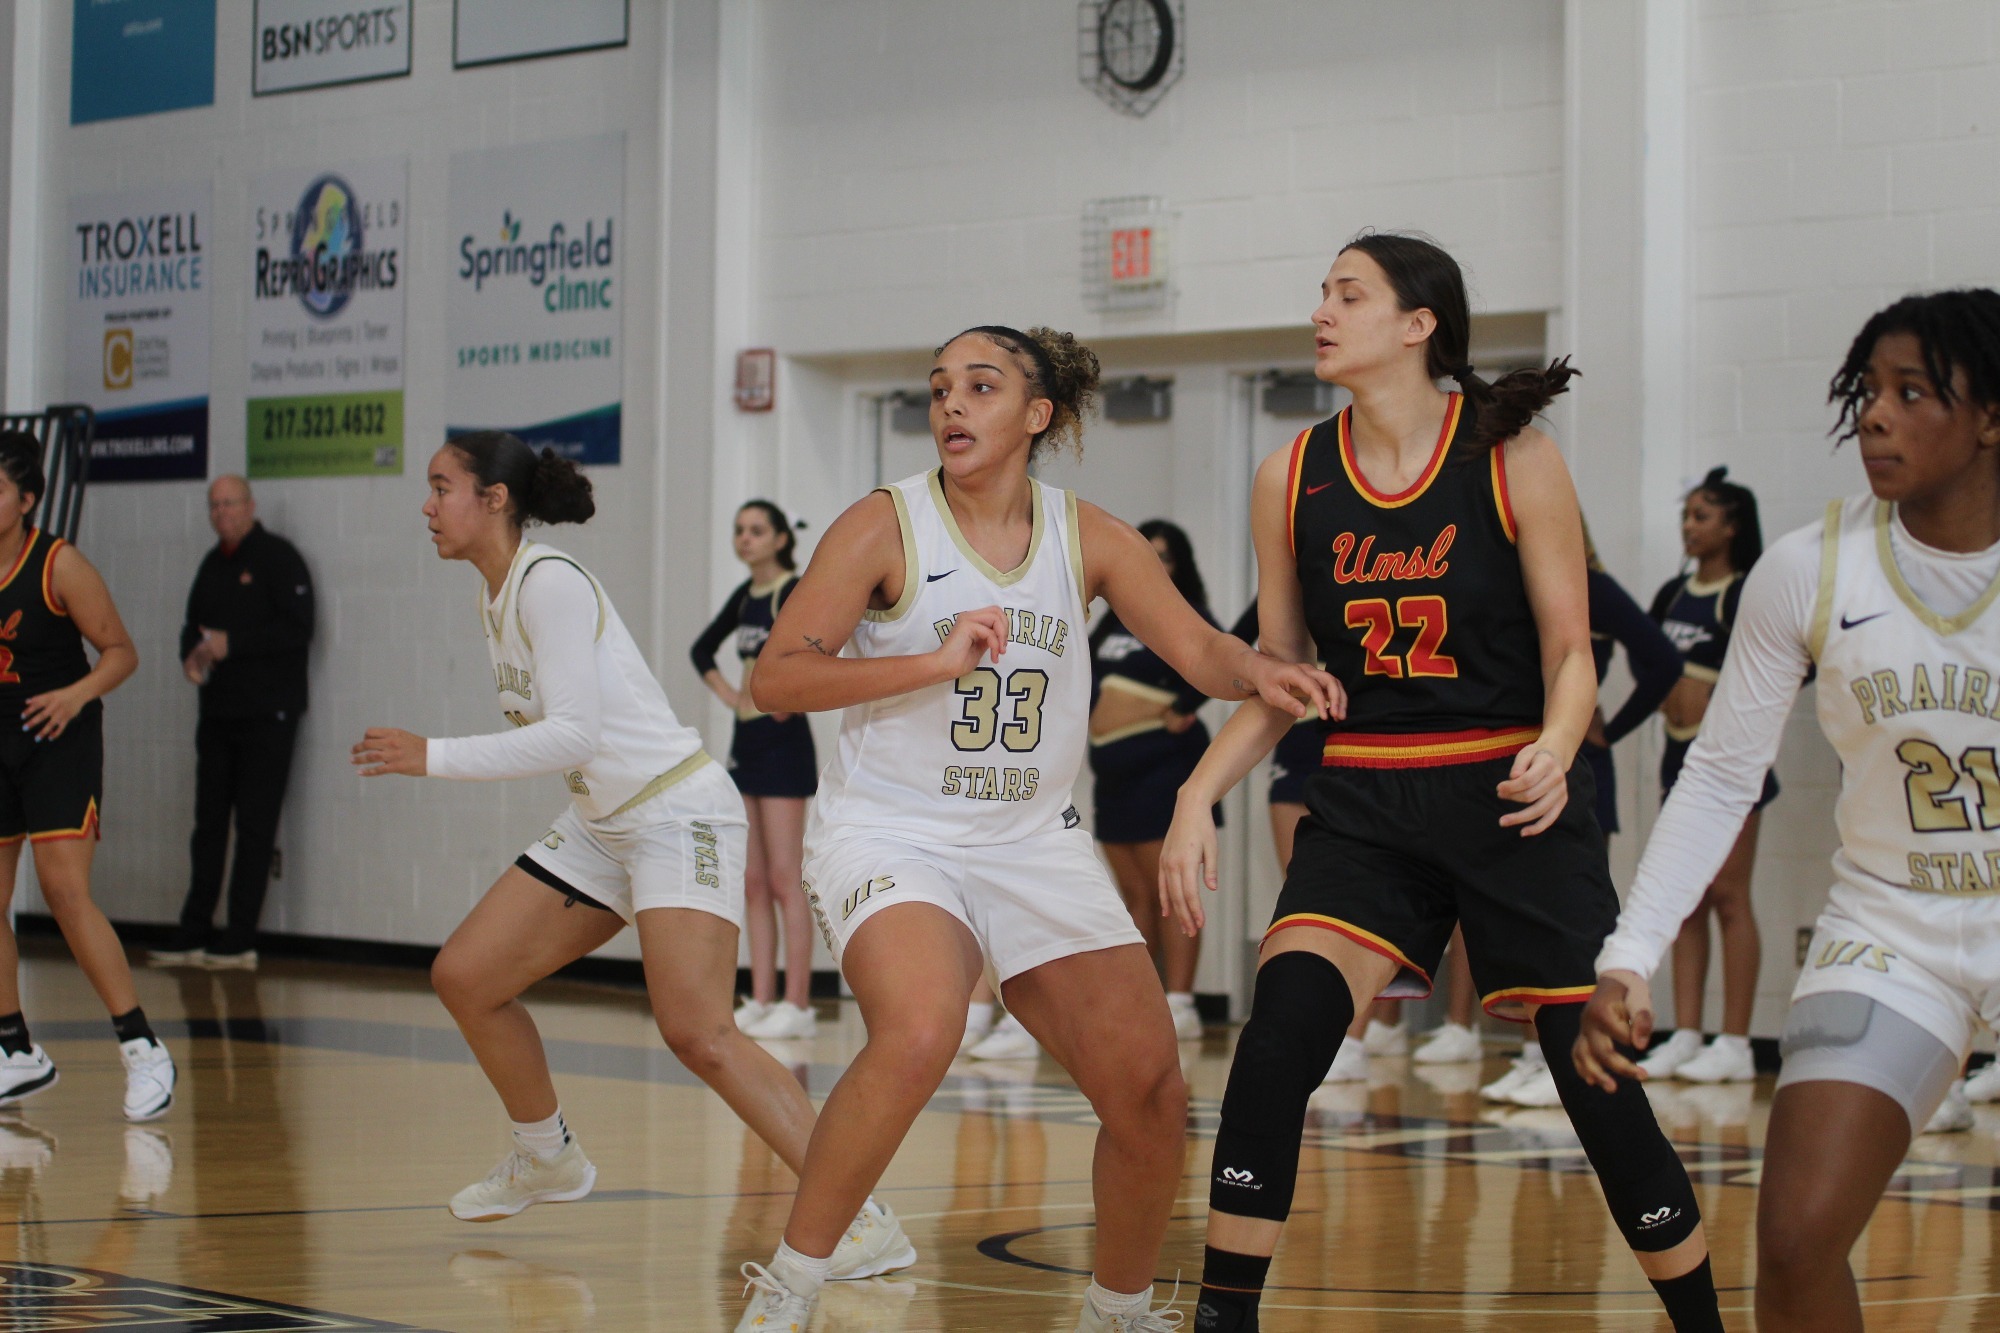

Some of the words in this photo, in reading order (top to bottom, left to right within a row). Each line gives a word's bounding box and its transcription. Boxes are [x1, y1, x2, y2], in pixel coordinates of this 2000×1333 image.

[76, 211, 201, 262] TROXELL
[459, 217, 613, 292] Springfield
[1111, 227, 1151, 281] EXIT
[78, 256, 202, 300] INSURANCE
[544, 274, 614, 313] clinic
[457, 343, 521, 368] SPORTS
[529, 337, 611, 363] MEDICINE
[264, 402, 386, 440] 217.523.4632
[1333, 524, 1457, 585] Umsl
[1344, 595, 1459, 679] 22
[950, 666, 1050, 753] 33
[941, 765, 1040, 802] STARS
[841, 874, 896, 921] UIS
[1814, 939, 1898, 974] UIS
